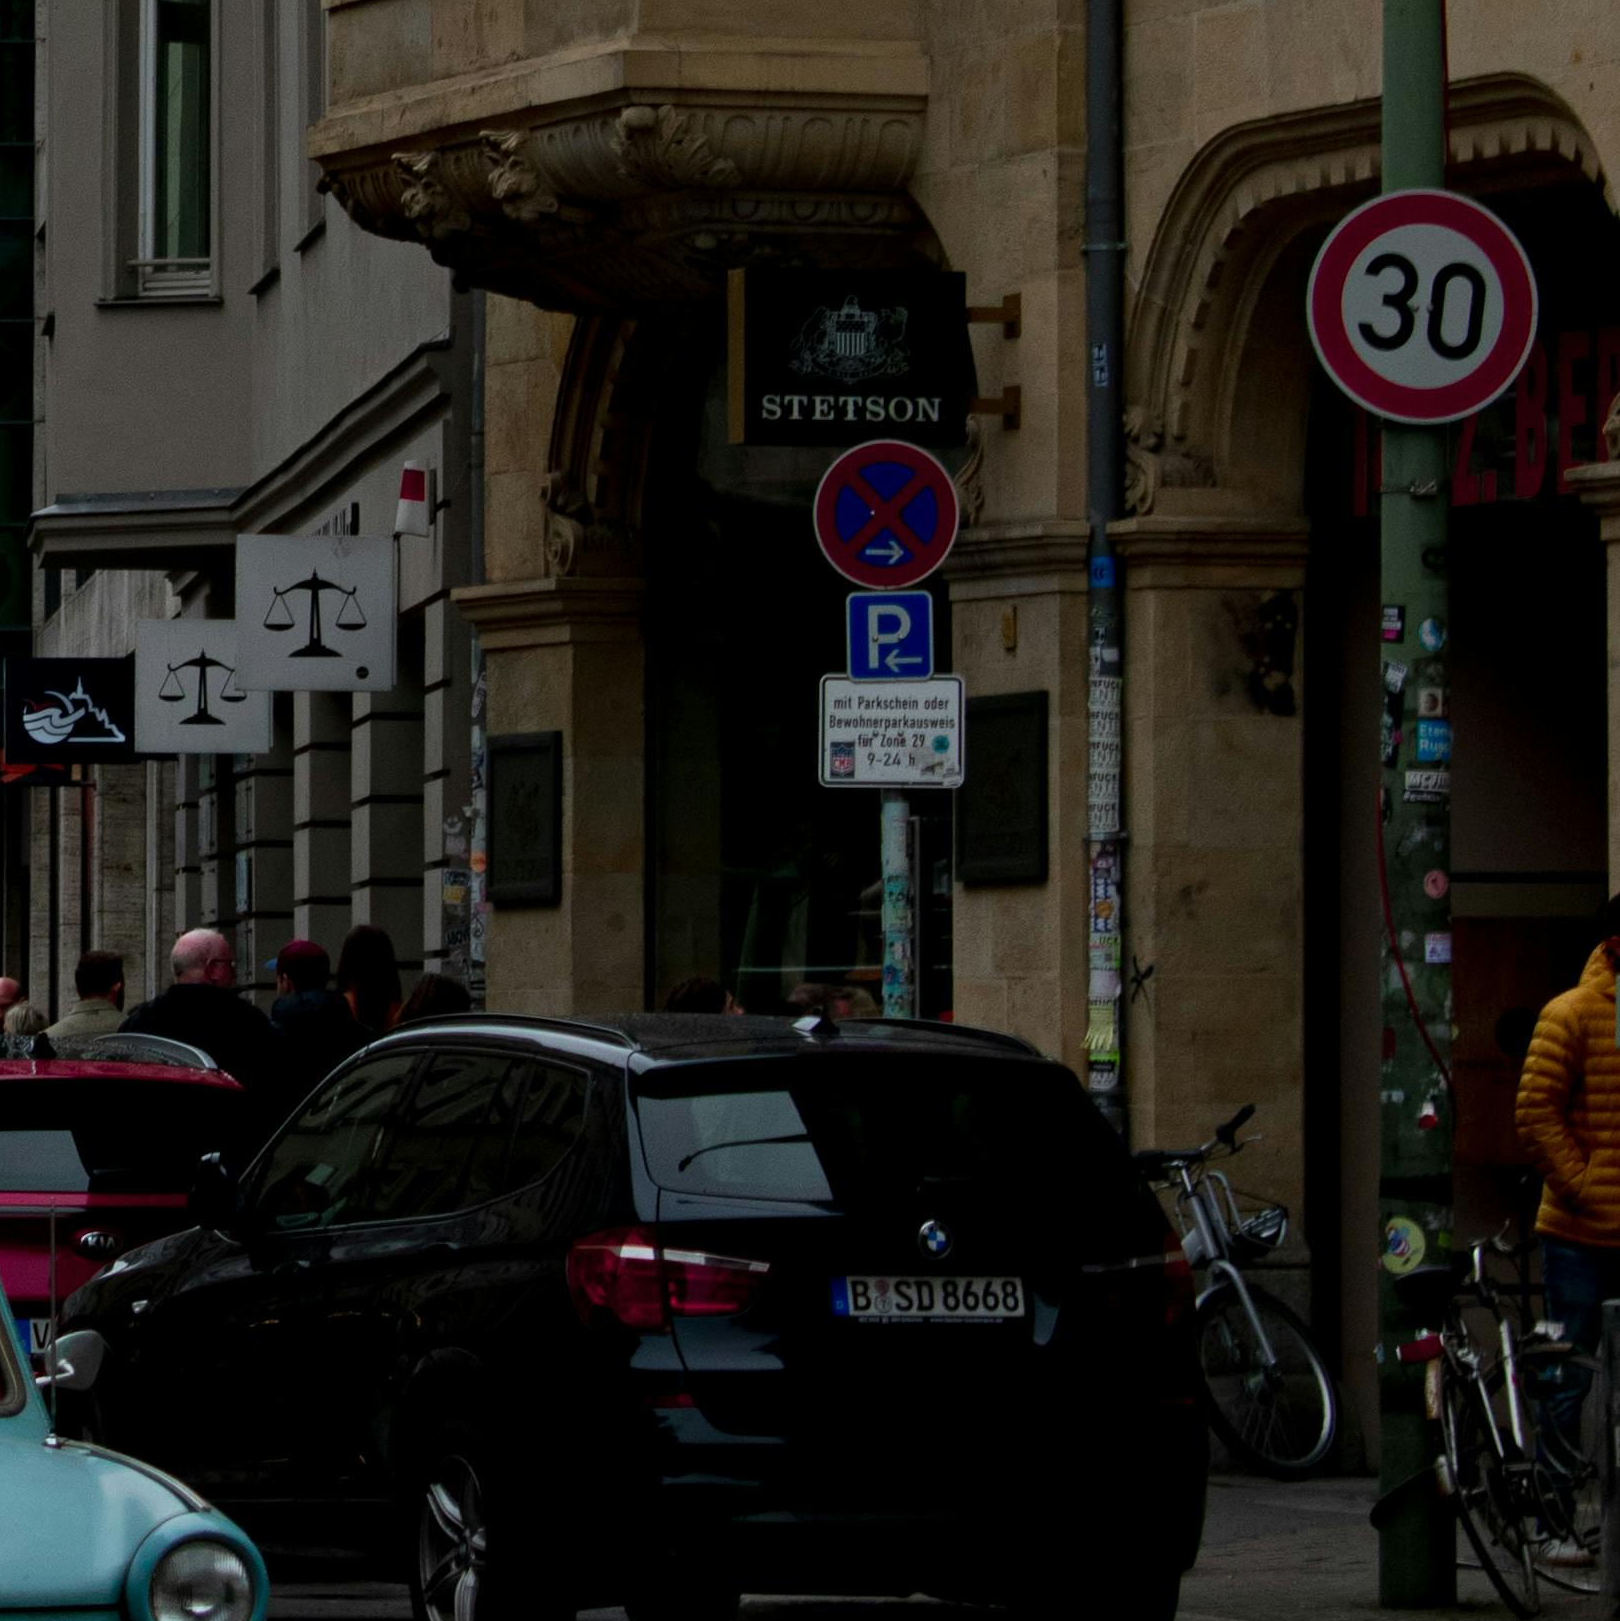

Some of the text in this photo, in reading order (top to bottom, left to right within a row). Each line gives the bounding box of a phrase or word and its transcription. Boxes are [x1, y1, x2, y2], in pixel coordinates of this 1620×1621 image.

[1359, 253, 1486, 360] 30
[761, 393, 942, 423] STETSON
[867, 604, 912, 669] P
[833, 696, 949, 710] mit Parkschein oder
[829, 714, 956, 731] Bewohnerparkausweis
[857, 733, 925, 748] für Zone 29
[867, 752, 916, 767] 9-24 h
[87, 1235, 117, 1250] KIA
[852, 1281, 871, 1311] B
[894, 1280, 934, 1312] SD
[942, 1280, 1019, 1312] 8668
